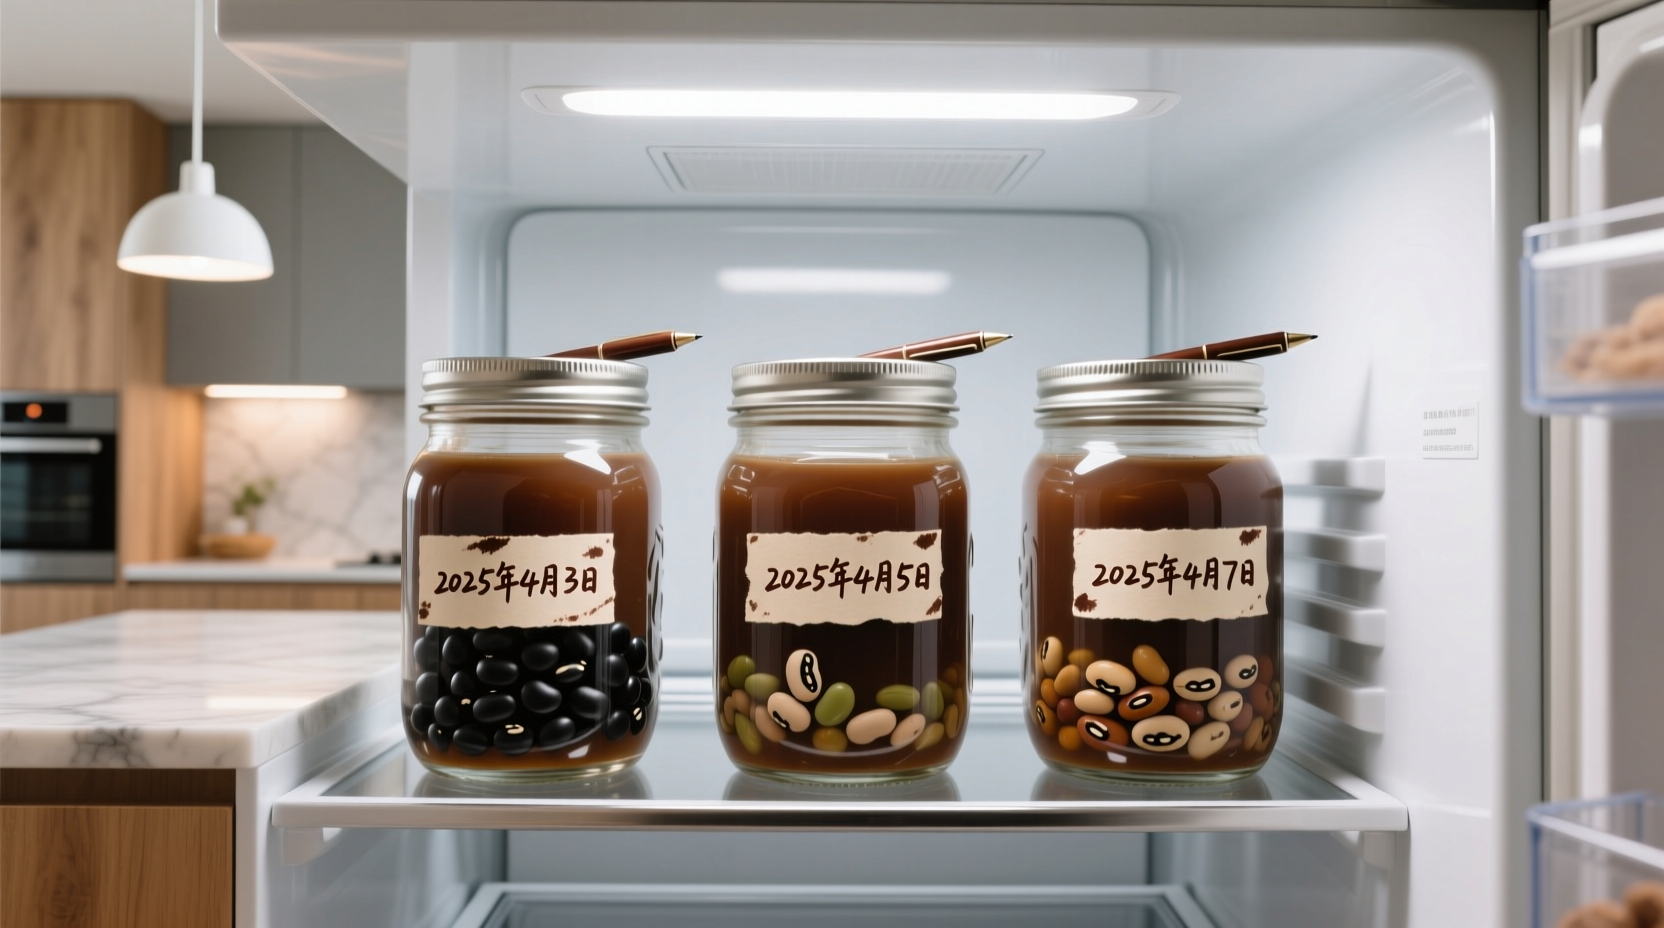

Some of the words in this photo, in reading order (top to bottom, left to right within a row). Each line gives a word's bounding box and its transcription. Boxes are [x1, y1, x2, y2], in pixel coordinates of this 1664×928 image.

[434, 561, 598, 604] 2025年4月3日
[764, 557, 930, 600] 2025年4月5日
[1091, 553, 1255, 596] 2025年4月7日
